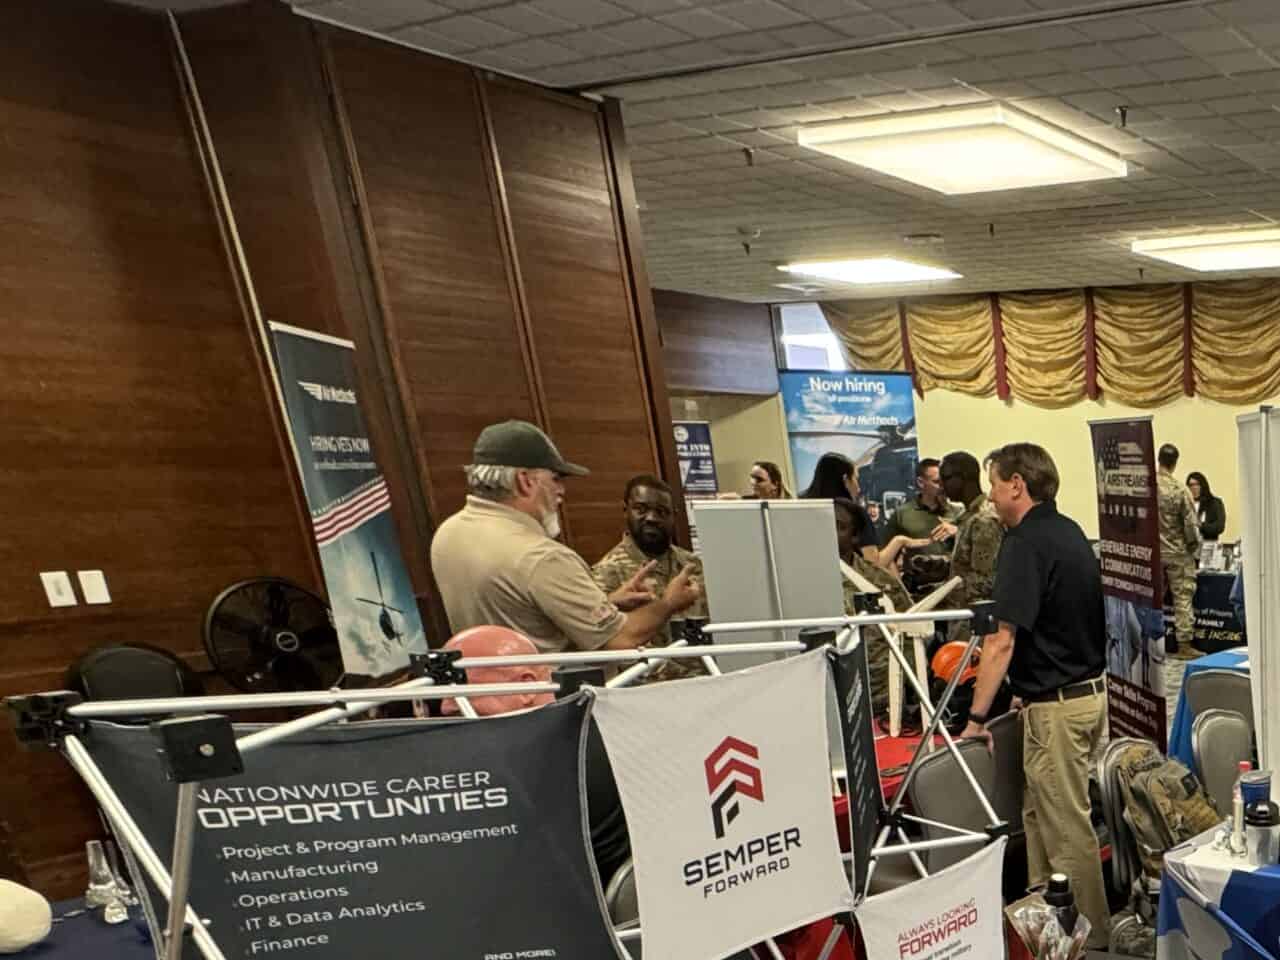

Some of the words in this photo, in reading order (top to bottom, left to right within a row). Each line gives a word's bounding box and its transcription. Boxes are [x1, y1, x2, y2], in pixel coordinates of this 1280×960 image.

[809, 376, 843, 392] Now
[844, 376, 886, 395] hiring
[197, 778, 380, 804] NATIONWIDE
[385, 771, 491, 795] CAREER
[197, 787, 509, 829] OPPORTUNITIES
[222, 842, 292, 861] Project
[296, 841, 311, 855] &
[314, 834, 397, 855] Program
[400, 822, 519, 847] Management
[683, 827, 802, 886] SEMPER
[231, 858, 379, 884] Manufacturing
[703, 856, 790, 899] FORWARD
[238, 885, 350, 909] Operations
[245, 917, 262, 932] IT
[267, 914, 282, 928] &
[286, 909, 334, 928] Data
[338, 899, 427, 921] Analytics
[898, 918, 936, 943] ALWAYS
[250, 932, 330, 956] Finance
[899, 908, 978, 960] FORWARD
